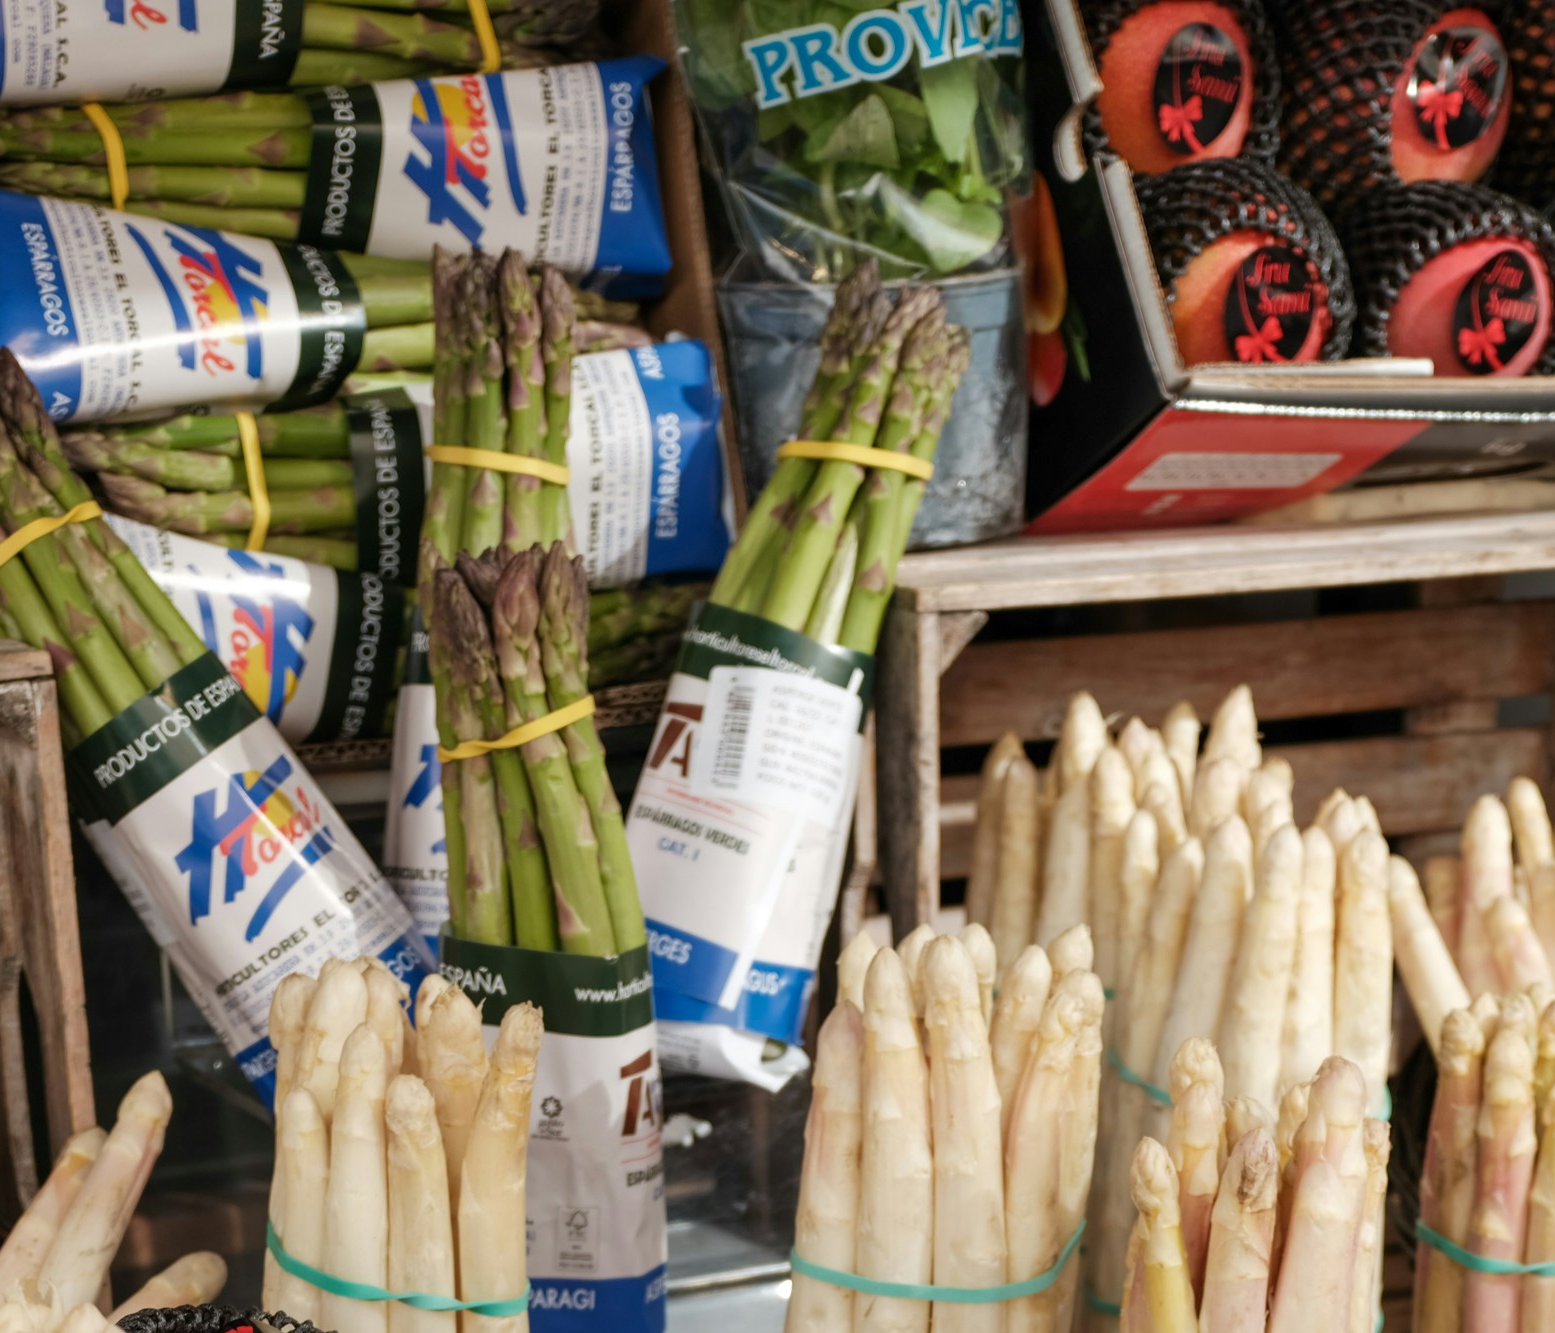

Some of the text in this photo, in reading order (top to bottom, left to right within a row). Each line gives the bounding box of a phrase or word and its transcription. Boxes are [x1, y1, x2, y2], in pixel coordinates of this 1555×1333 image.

[321, 125, 357, 236] PRODUCTOS
[606, 81, 635, 213] ESPÁRRAGOS
[21, 222, 70, 336] ESPÁRRAGOS
[376, 456, 397, 483] DE
[653, 411, 681, 538] ESPÁRRAGOS
[93, 694, 212, 789] PRODUCTOS DE
[348, 676, 372, 702] DE
